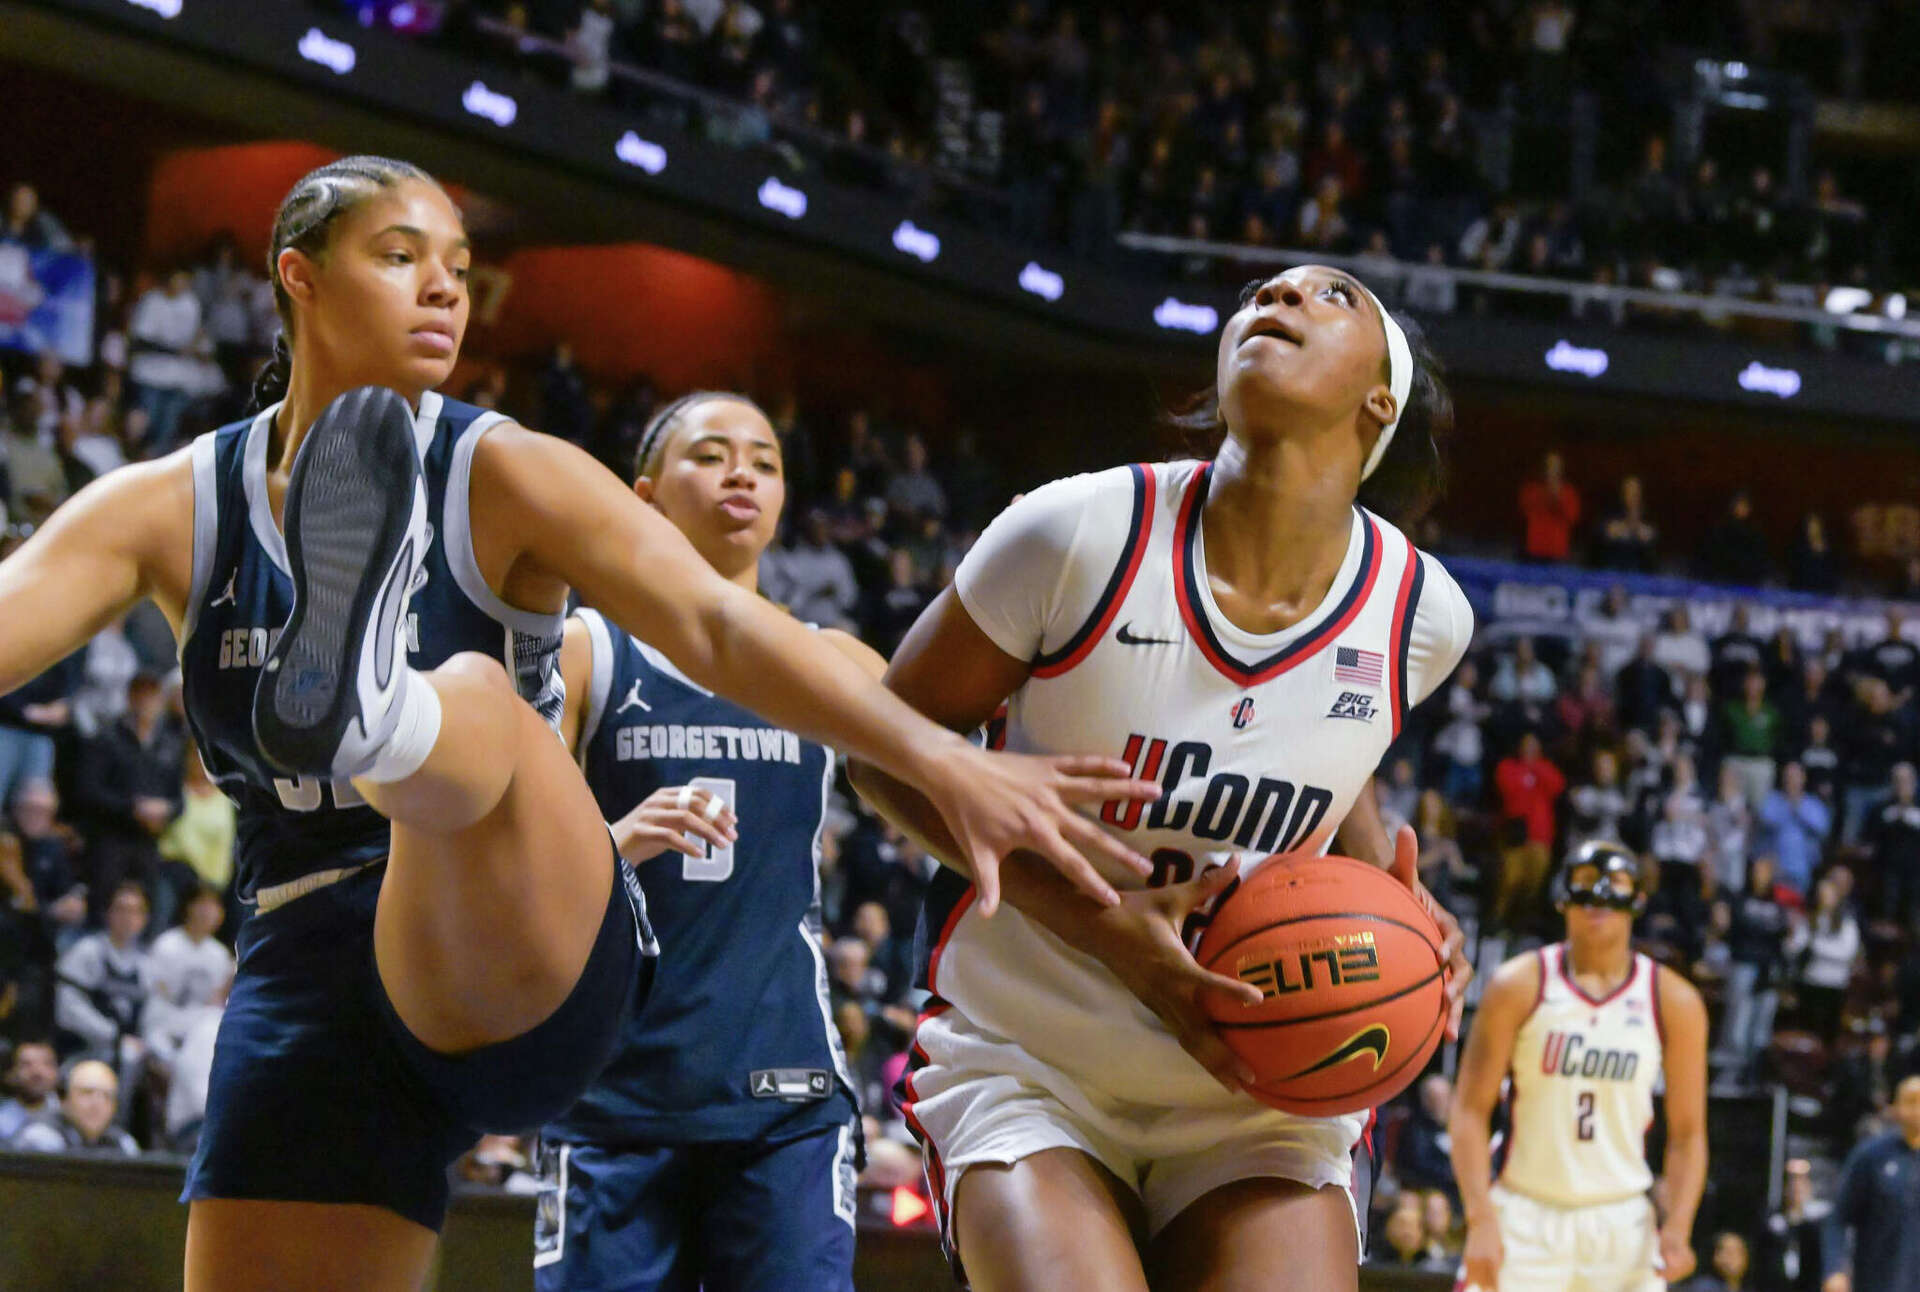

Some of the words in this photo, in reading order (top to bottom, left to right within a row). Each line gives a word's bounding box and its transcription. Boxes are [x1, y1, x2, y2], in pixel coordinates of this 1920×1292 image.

[1331, 703, 1379, 719] EAST
[1337, 691, 1373, 706] BIG
[616, 725, 801, 765] GEORGETOWN
[1238, 945, 1380, 1005] ELITE
[1540, 1030, 1639, 1081] UConn
[1577, 1091, 1595, 1142] 2
